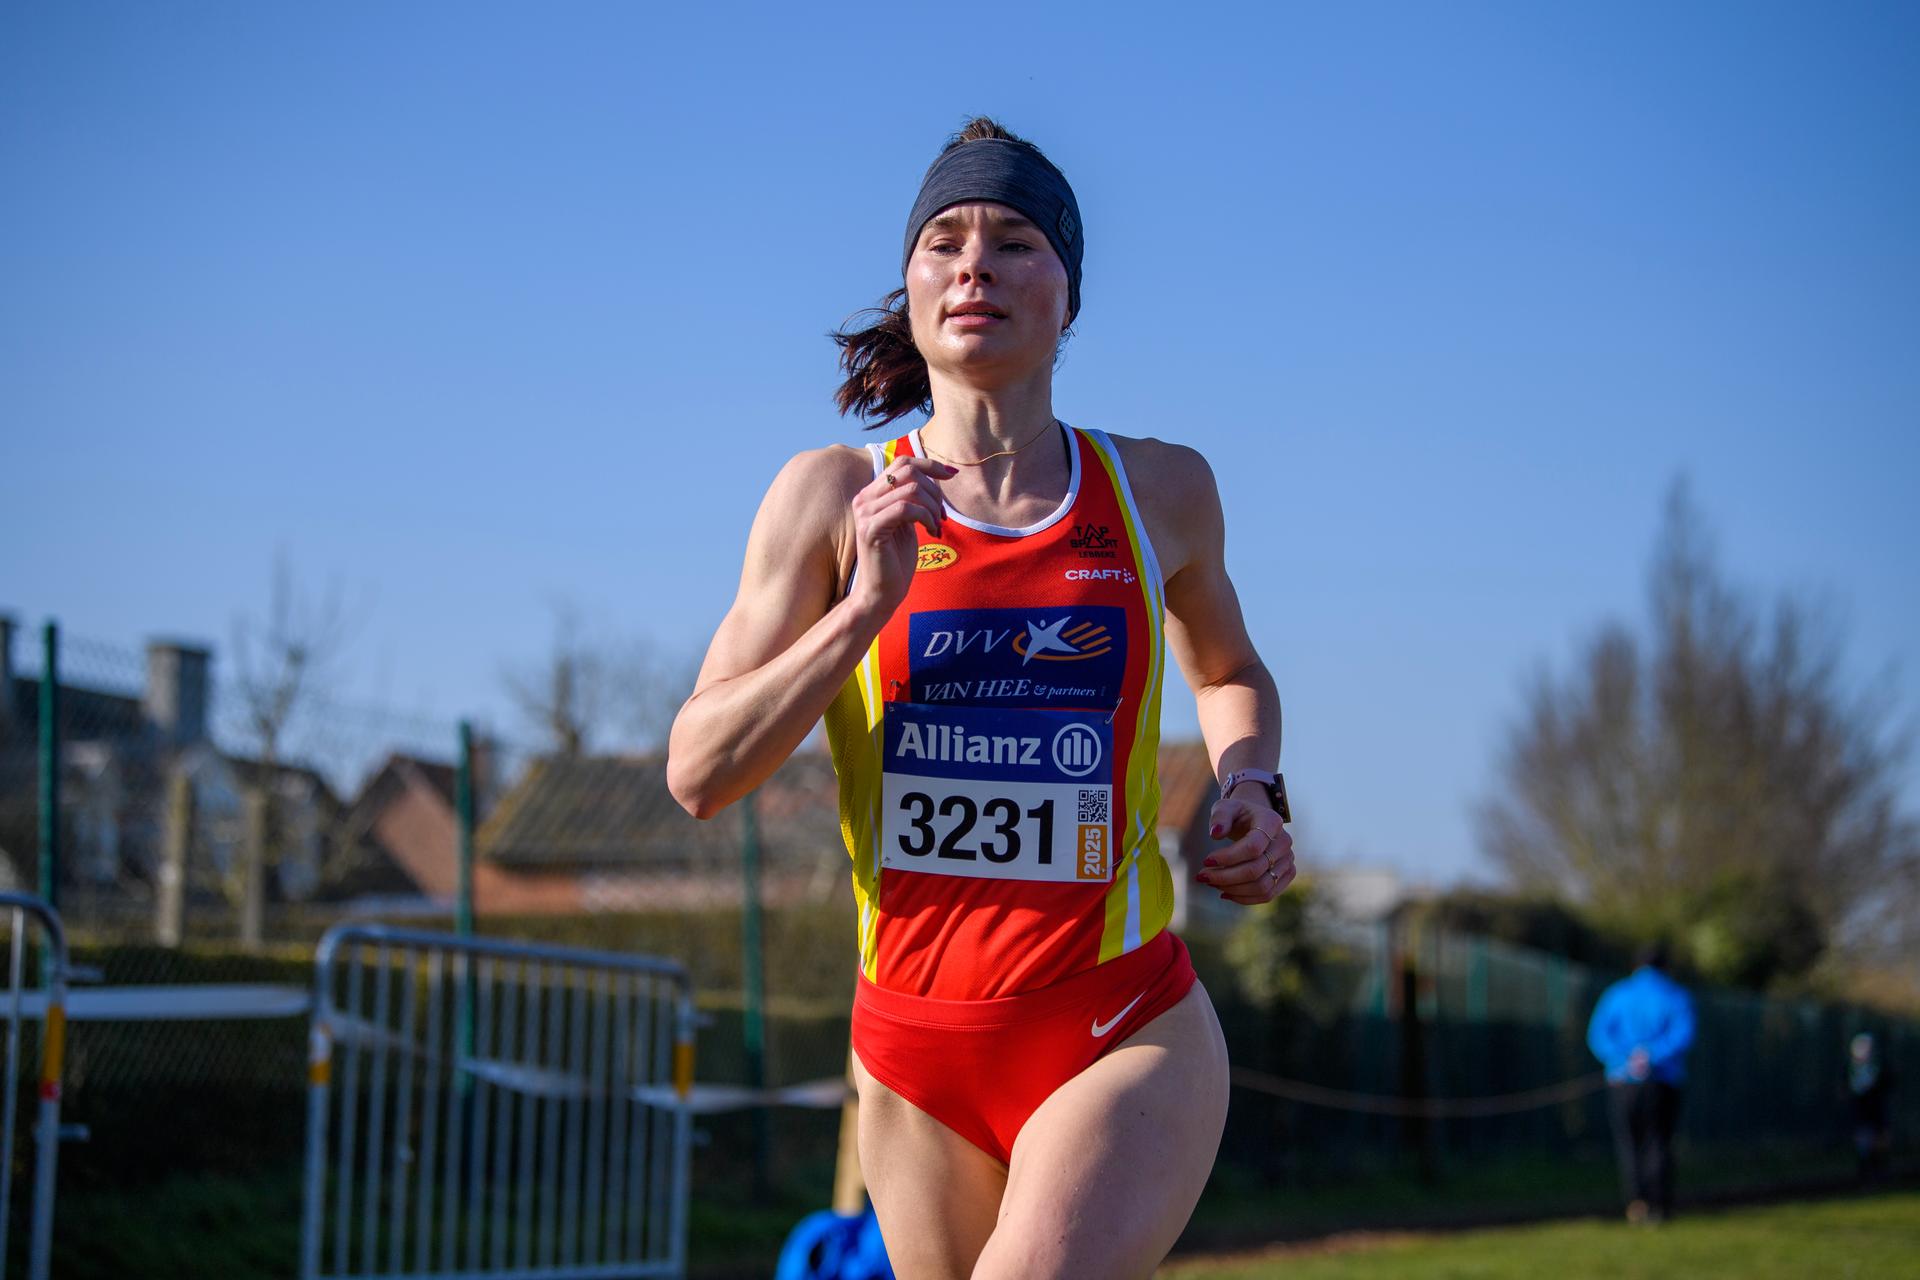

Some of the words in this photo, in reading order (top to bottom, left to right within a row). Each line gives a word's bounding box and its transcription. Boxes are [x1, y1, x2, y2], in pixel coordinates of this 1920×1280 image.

[1064, 569, 1121, 581] CRAFT
[923, 629, 1011, 658] DVV
[924, 681, 973, 702] VAN
[974, 679, 1031, 698] HEE
[1033, 684, 1047, 696] &
[1047, 685, 1096, 700] partners
[896, 721, 1041, 766] Allianz
[898, 792, 1055, 865] 3231
[1084, 827, 1101, 876] 2025
